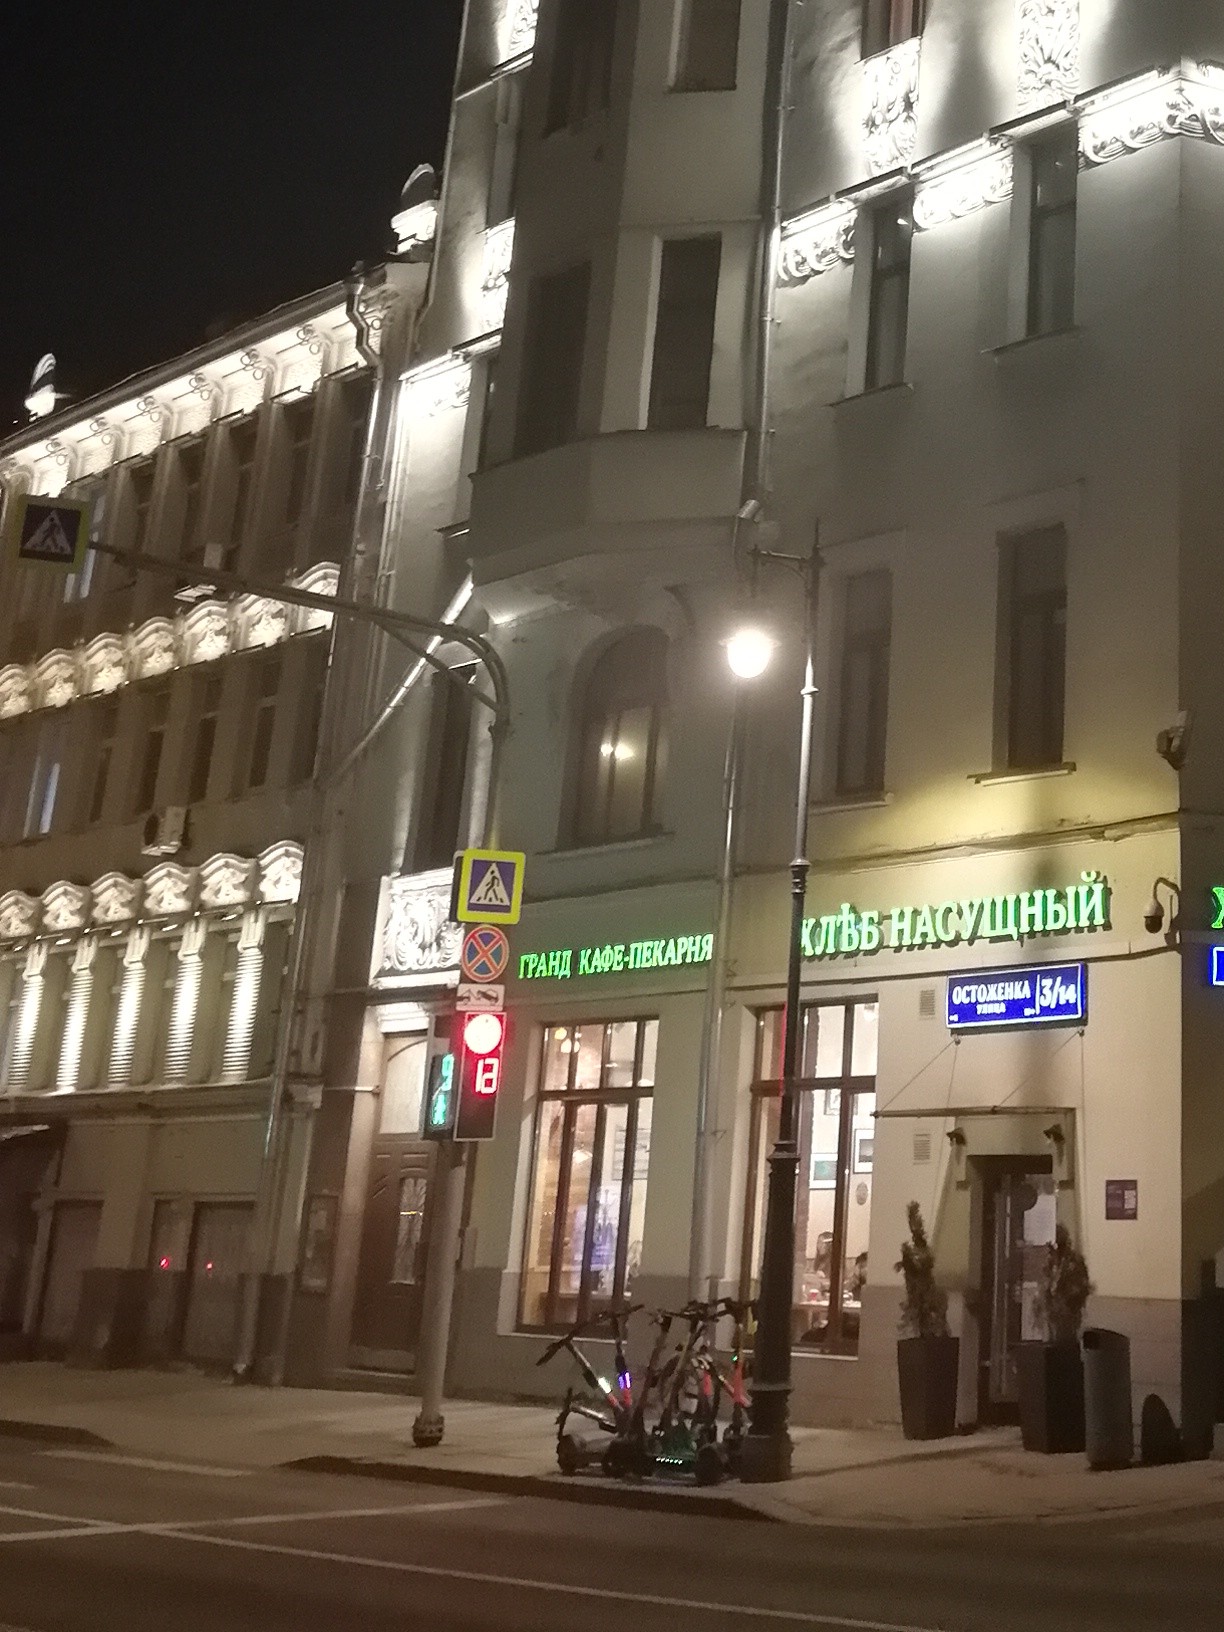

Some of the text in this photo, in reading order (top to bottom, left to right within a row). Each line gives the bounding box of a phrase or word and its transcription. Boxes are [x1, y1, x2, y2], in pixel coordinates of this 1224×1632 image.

[890, 870, 1106, 948] НАСУЩНЫЙ
[518, 933, 714, 980] ГРАНД КАФЕ-ПЕКАРНЯ
[952, 975, 1077, 1009] ОСТОЖЕНКА 3/14
